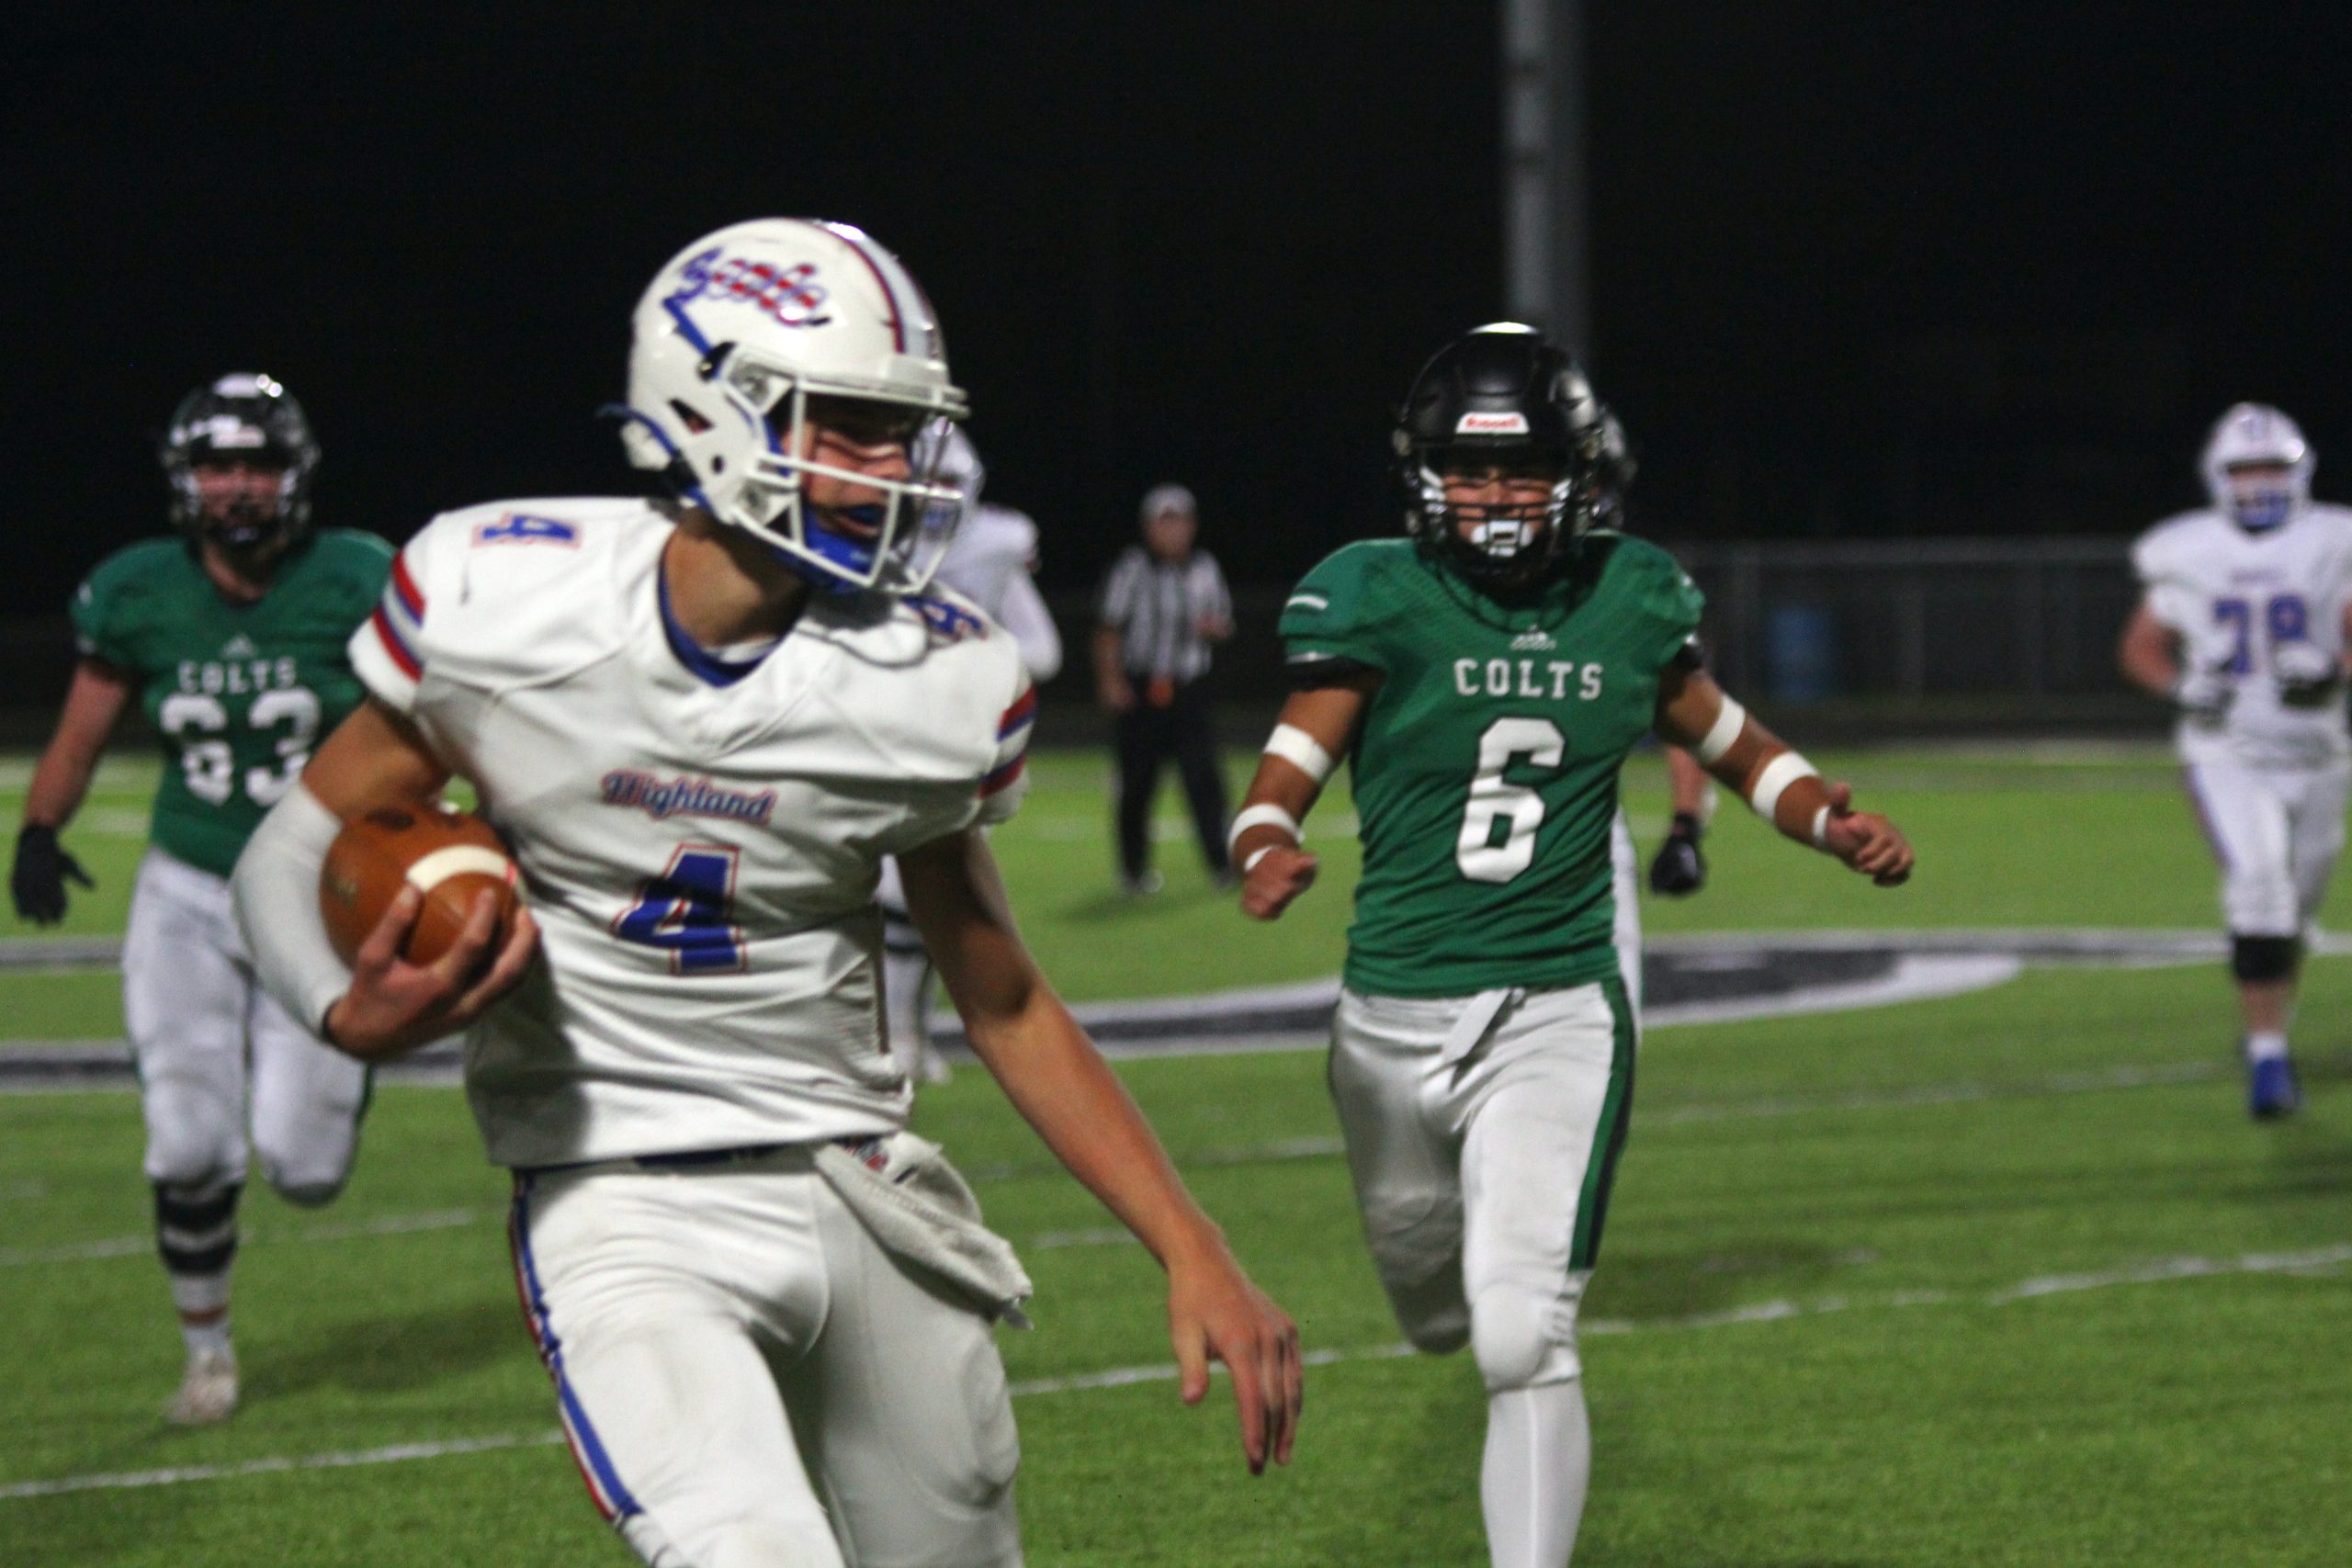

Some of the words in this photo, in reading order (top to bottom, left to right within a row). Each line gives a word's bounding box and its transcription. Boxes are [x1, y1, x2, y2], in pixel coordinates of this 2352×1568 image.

[470, 513, 584, 549] 4
[177, 657, 297, 695] COLTS
[1454, 658, 1604, 700] COLTS
[160, 687, 320, 807] 63
[602, 770, 778, 826] Highland
[1457, 716, 1565, 884] 6
[611, 841, 749, 977] 4
